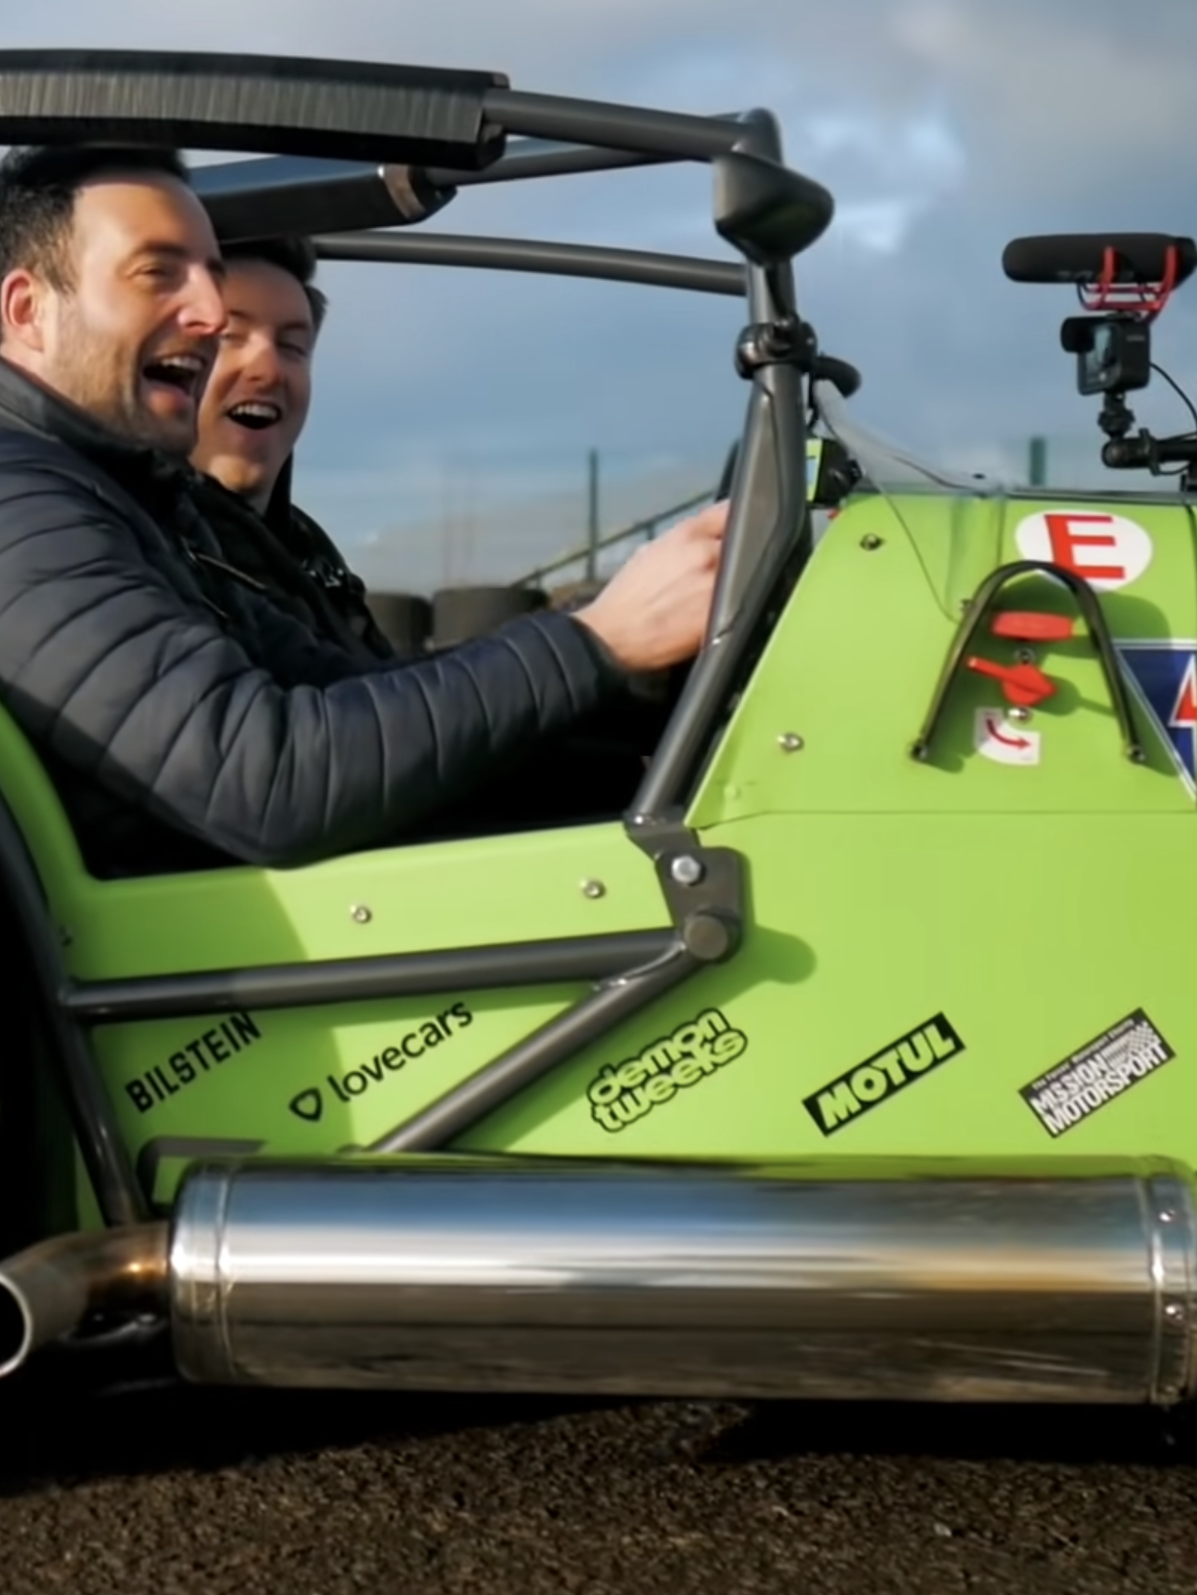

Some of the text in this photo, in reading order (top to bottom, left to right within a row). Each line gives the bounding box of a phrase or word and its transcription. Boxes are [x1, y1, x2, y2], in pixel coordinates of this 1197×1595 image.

[1044, 514, 1127, 580] E
[125, 1011, 261, 1113] BILSTEIN
[326, 1001, 473, 1102] lovecars
[587, 1007, 731, 1106] demon
[591, 1028, 748, 1133] tweeks
[816, 1022, 956, 1130] MOTUL
[1030, 1053, 1109, 1115] MISSION
[1042, 1040, 1168, 1135] MOTORSPORT
